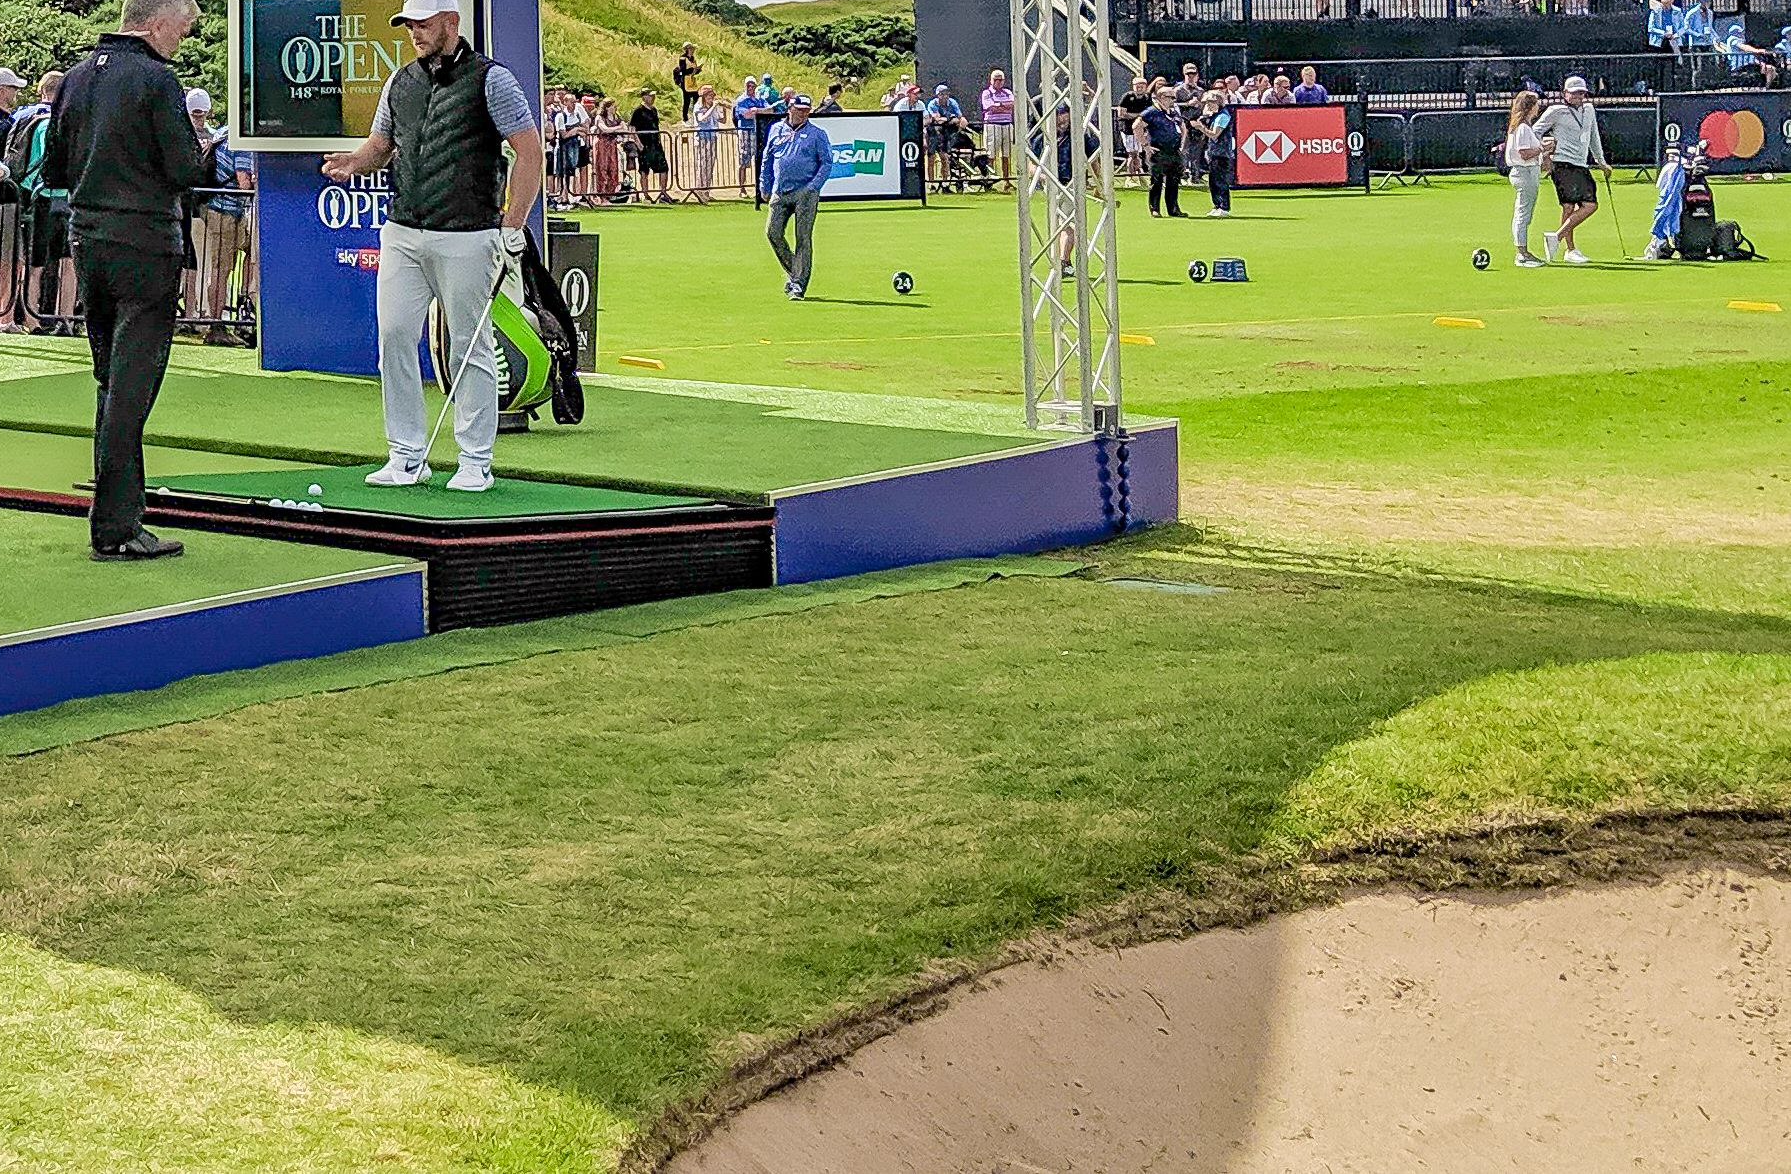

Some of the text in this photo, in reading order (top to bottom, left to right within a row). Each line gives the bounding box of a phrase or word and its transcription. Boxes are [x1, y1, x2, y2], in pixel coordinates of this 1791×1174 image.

[315, 14, 368, 39] THE
[281, 36, 405, 84] OPEN
[1299, 138, 1344, 154] HSBC
[349, 168, 389, 190] THE
[317, 185, 389, 229] OPE
[337, 249, 359, 267] sky
[1475, 252, 1489, 266] 22
[1191, 265, 1206, 278] 23
[895, 277, 912, 290] 24
